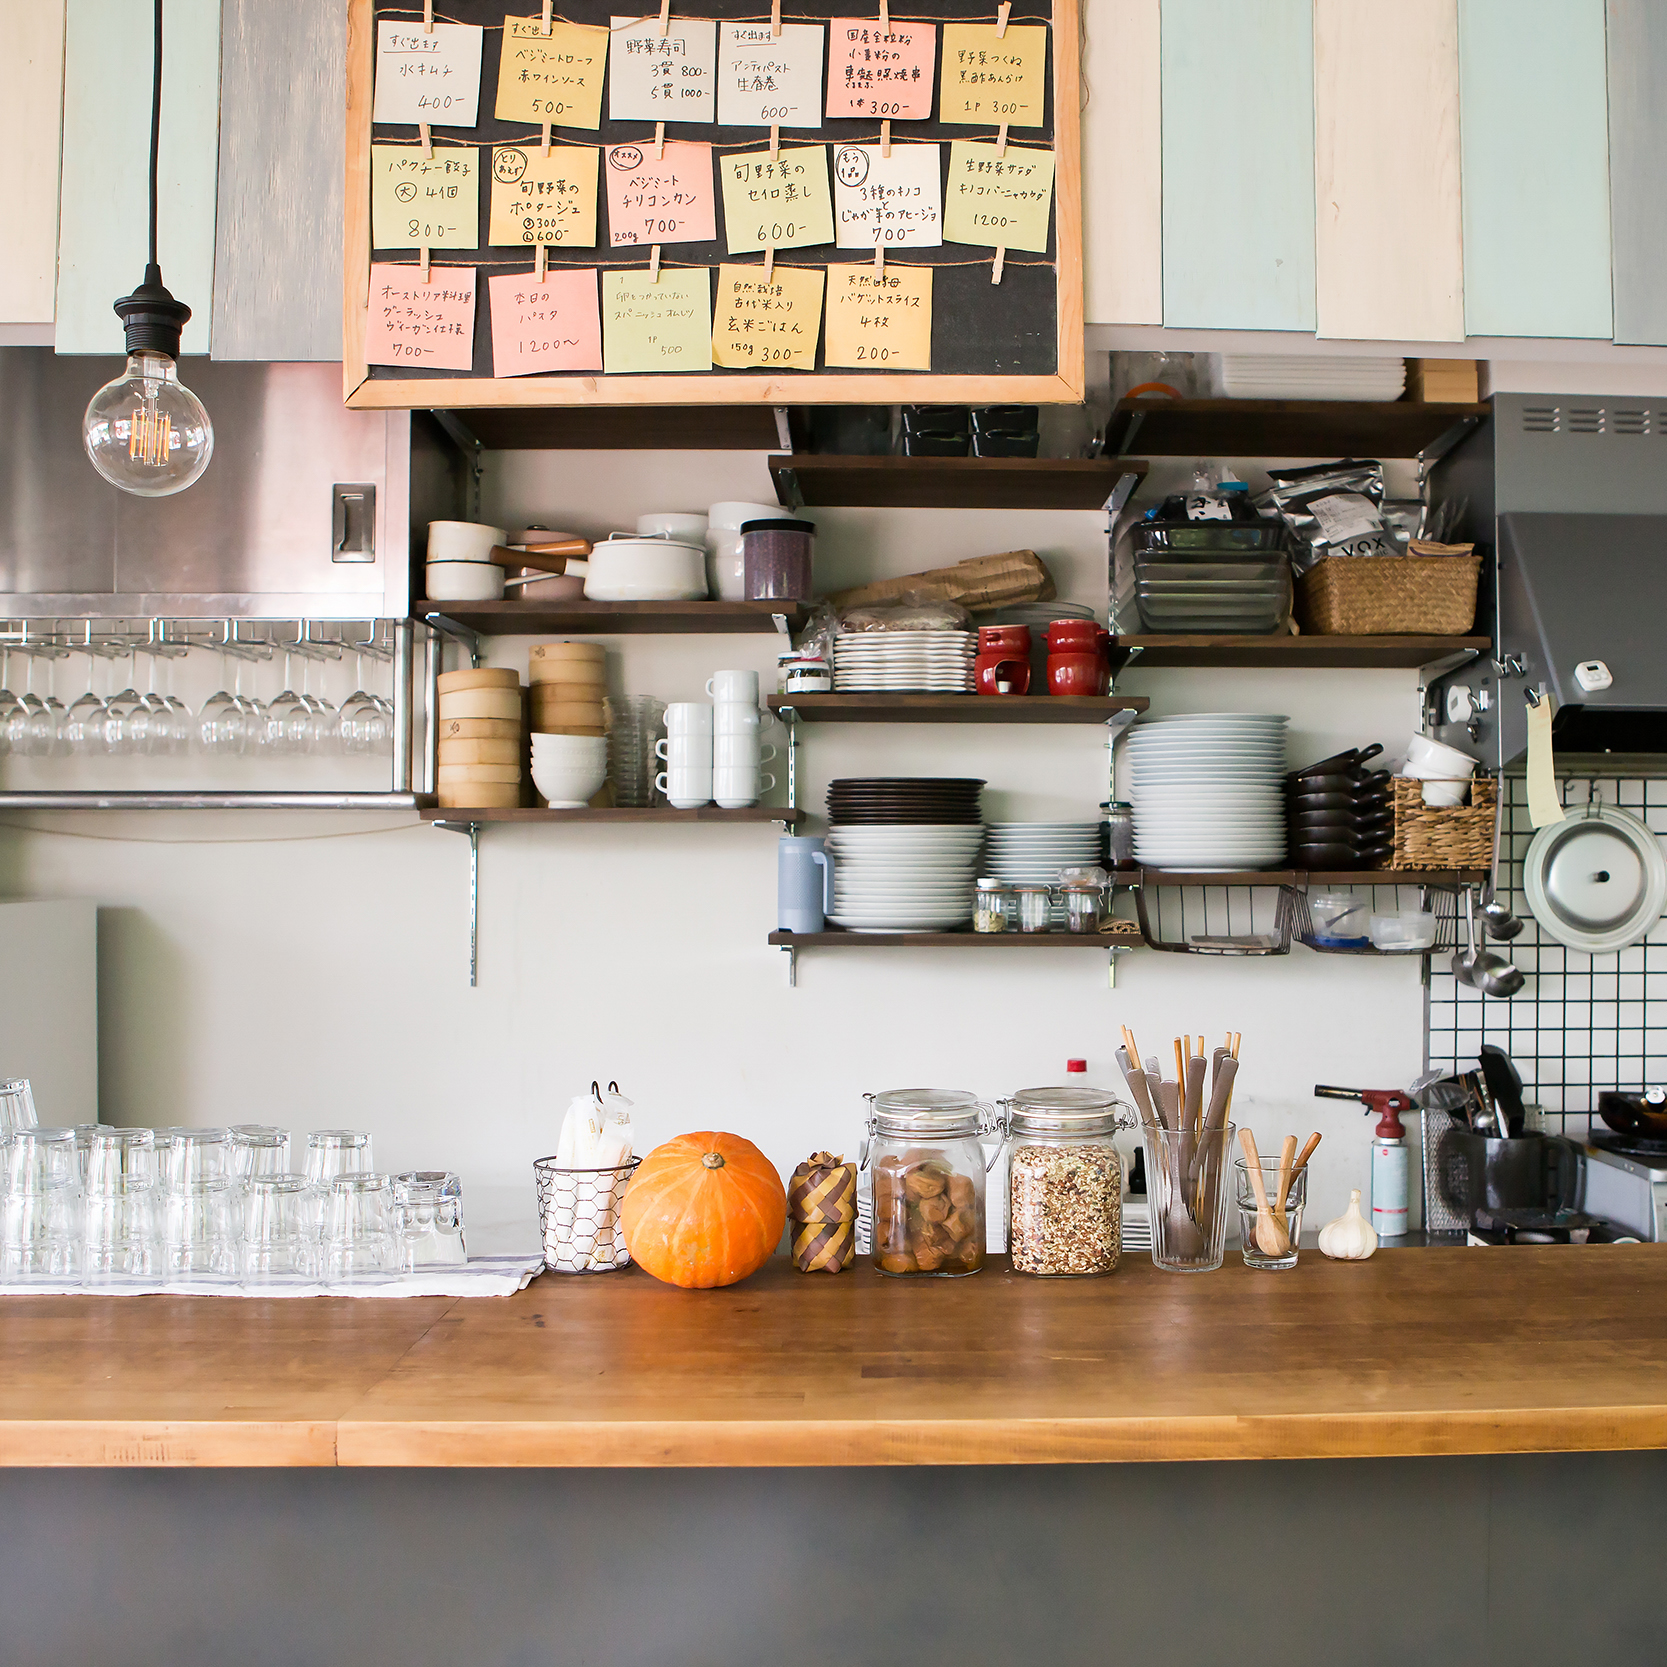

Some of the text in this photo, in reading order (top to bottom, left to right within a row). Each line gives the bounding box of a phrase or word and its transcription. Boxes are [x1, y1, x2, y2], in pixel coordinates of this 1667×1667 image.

[389, 34, 439, 51] すぐ出ます
[626, 38, 686, 57] 野菜寿司
[515, 48, 593, 66] ベジミートローフ
[849, 48, 901, 62] 小麦粉の
[957, 49, 1023, 67] 野菜つくね
[399, 63, 453, 78] 水キムチ
[731, 60, 791, 74] アンティパスト
[518, 68, 586, 87] 赤ワインソース
[737, 75, 779, 92] 生春巻
[388, 158, 471, 177] パクチー餃子
[733, 159, 806, 183] 旬野菜の
[965, 158, 1037, 177] 生野菜サラダ
[520, 179, 580, 197] 旬野菜の
[629, 174, 680, 190] ベジミート
[622, 192, 697, 209] チリコンカン
[747, 182, 812, 204] セイロ蒸し
[859, 184, 922, 201] 3種のキノコ
[509, 200, 581, 216] ポタージュ
[841, 205, 937, 224] じゃが芋のアヒージョ
[614, 231, 639, 243] 200g
[381, 284, 472, 304] オーストリア料理
[733, 280, 783, 296] 自然栽培
[734, 296, 793, 312] 古代米入り
[840, 292, 921, 308] バゲットスライス
[383, 305, 444, 321] グーラッシュ
[519, 310, 558, 324] パスタ
[860, 315, 890, 328] 4枚
[386, 320, 465, 336] ヴィーガン仕様
[727, 315, 804, 334] 玄米ごはん
[660, 345, 683, 356] 500
[731, 342, 754, 356] 150g
